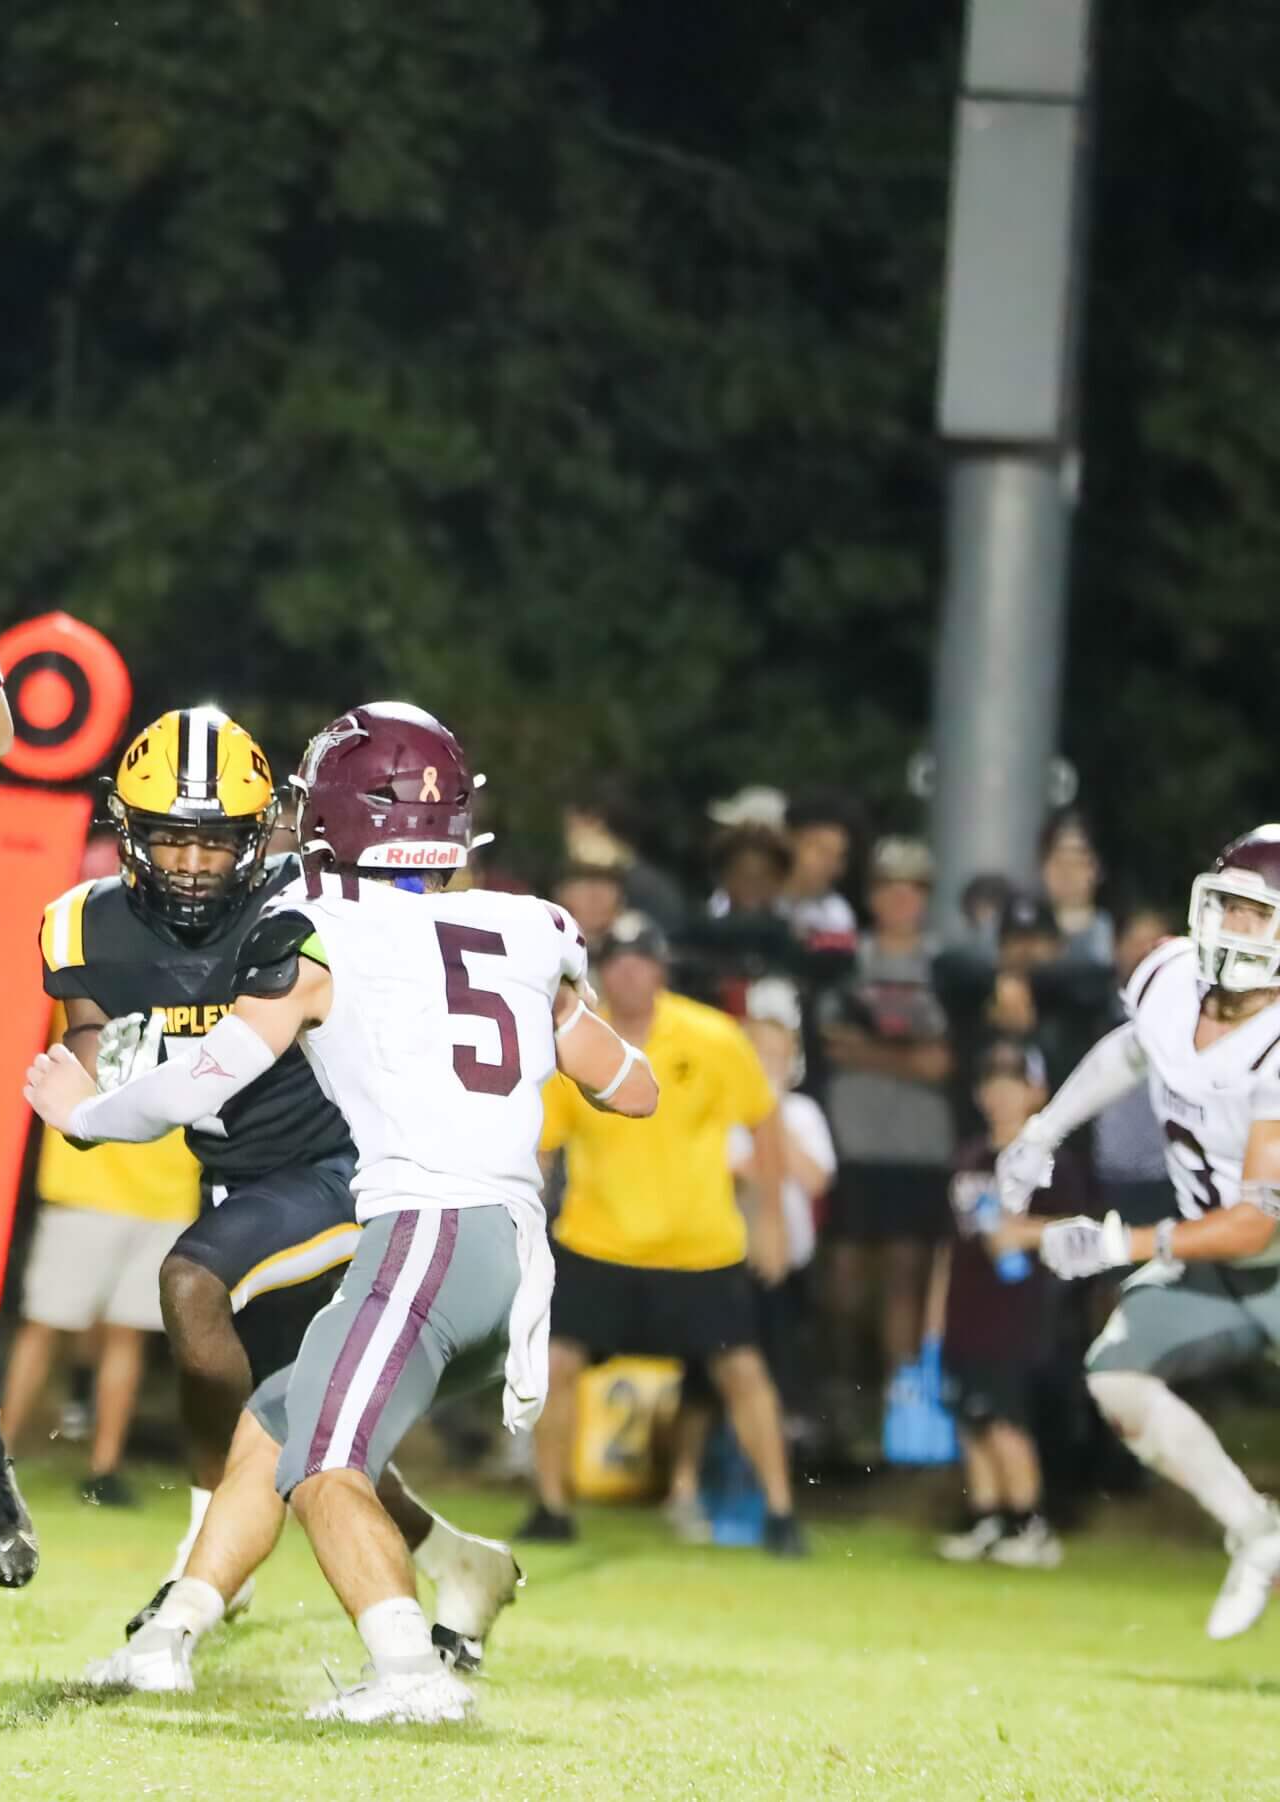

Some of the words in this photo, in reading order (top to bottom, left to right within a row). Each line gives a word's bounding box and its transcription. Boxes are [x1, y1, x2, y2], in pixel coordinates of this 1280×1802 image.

[385, 847, 459, 865] Riddell
[151, 1004, 235, 1034] IPLE
[435, 921, 522, 1096] 5
